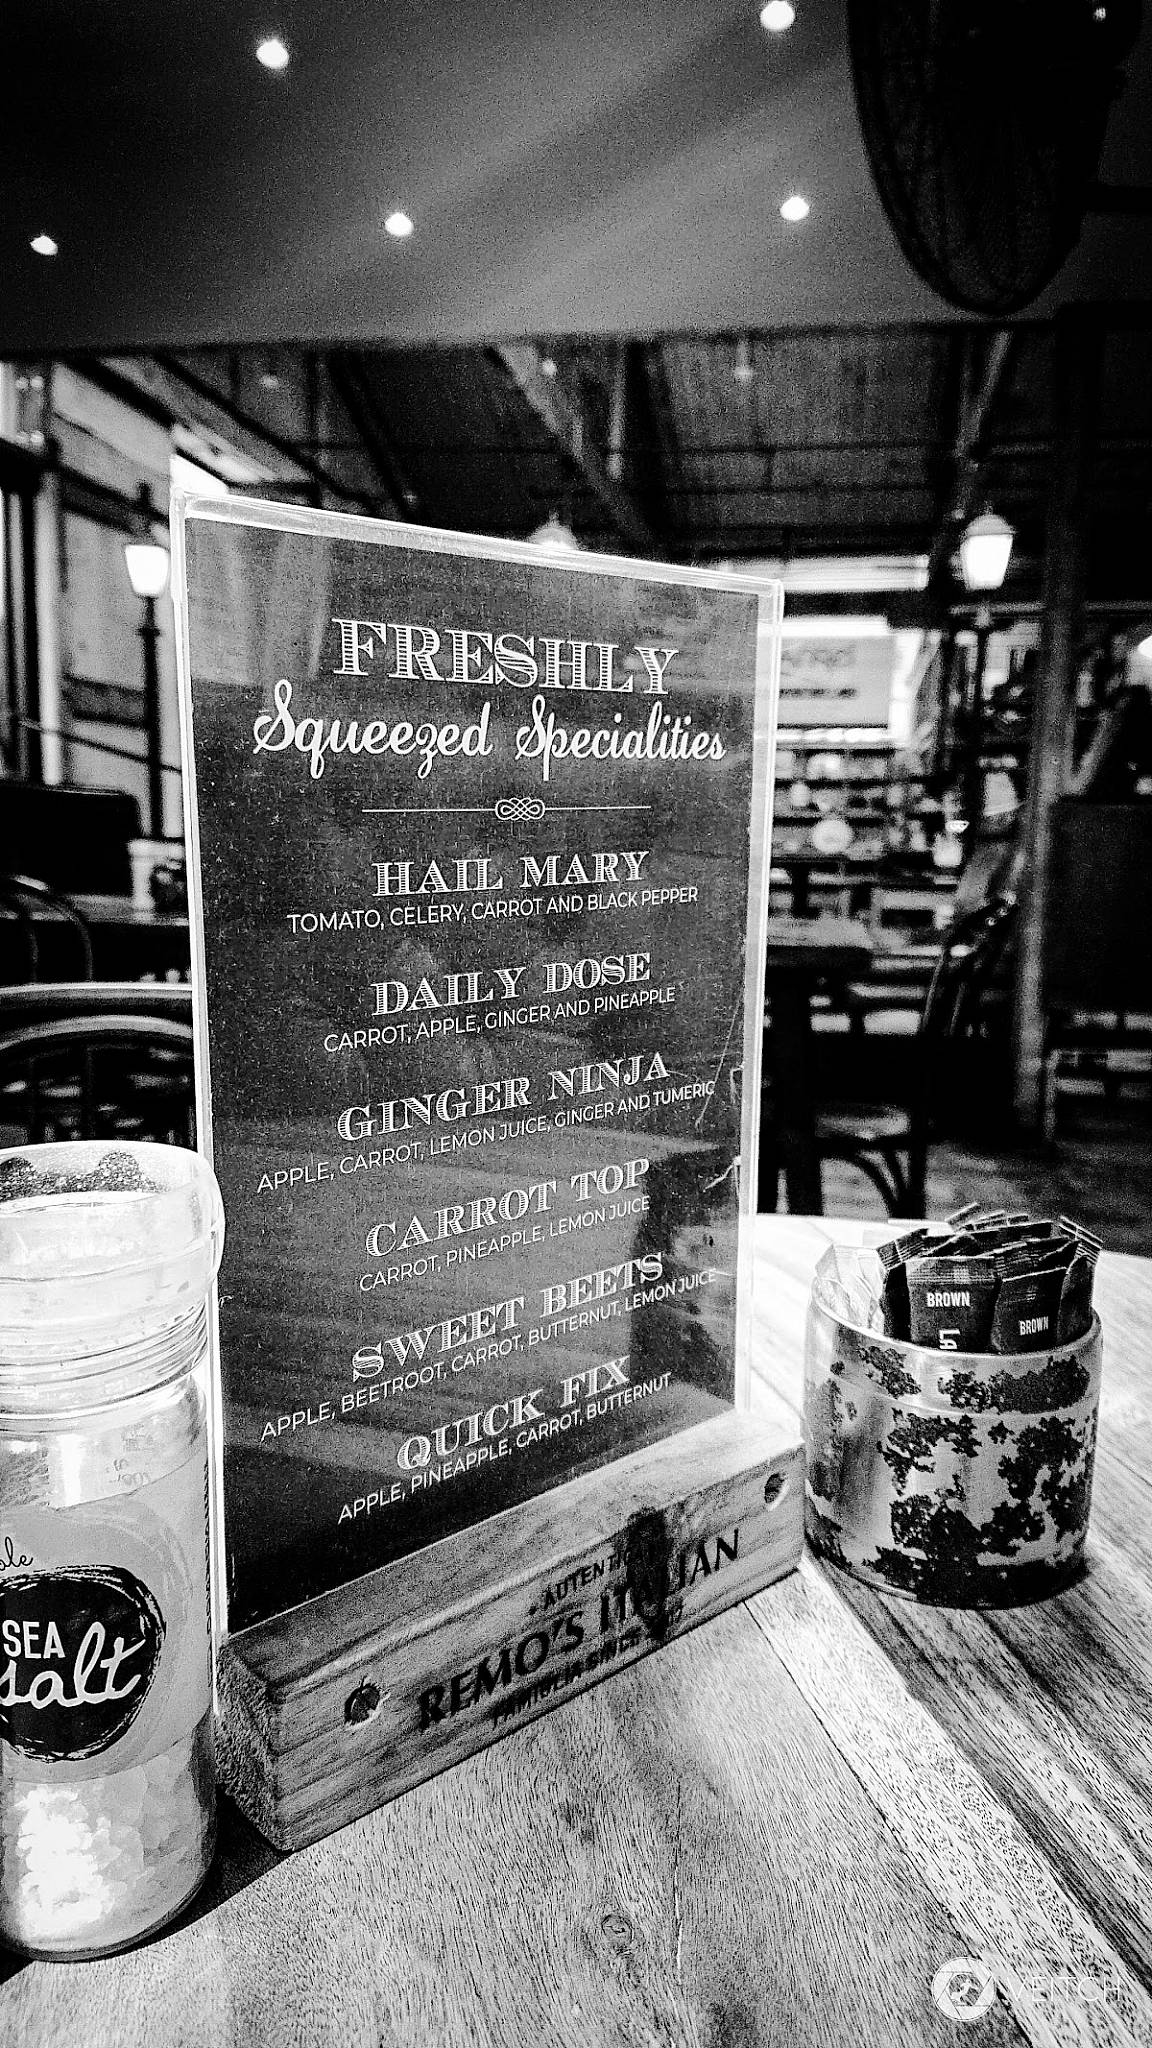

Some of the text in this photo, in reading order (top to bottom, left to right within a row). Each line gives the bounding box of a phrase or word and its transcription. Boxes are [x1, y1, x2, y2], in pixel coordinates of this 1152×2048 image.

[331, 618, 680, 695] FRESHLY
[252, 679, 727, 782] Squeezed Specialities
[286, 887, 699, 934] TOMATO, CELERY, CARROT AND BLACK PEPPER
[371, 851, 650, 897] HAIL MARY
[323, 987, 676, 1052] CARROT, APPLE, GINGER AND PINEAPPLE
[370, 953, 651, 1017] DAILY DOSE
[256, 1081, 716, 1194] APPLE, CARROT, LEMON JUICE, GINGER AND TUMERIC
[337, 1052, 671, 1141] GINGER NINJA
[359, 1195, 650, 1292] CARROT, PINEAPPLE, LEMON JUICE
[365, 1158, 650, 1257] CARROT TOP
[352, 1252, 663, 1383] SWEET BEETS
[926, 1291, 971, 1308] BROWN
[1019, 1316, 1049, 1336] BROWN
[260, 1269, 717, 1443] APPLE, BEETROOT, CARROT, BUTTERNUT, LEMON JUICE
[337, 1372, 672, 1525] APPLE, PINEAPPLE, CARROT, BUTTERNUT
[396, 1355, 631, 1471] QUICK FIX
[0, 1621, 147, 1709] salt
[2, 1619, 66, 1659] SEA
[416, 1610, 586, 1731] REMO'S
